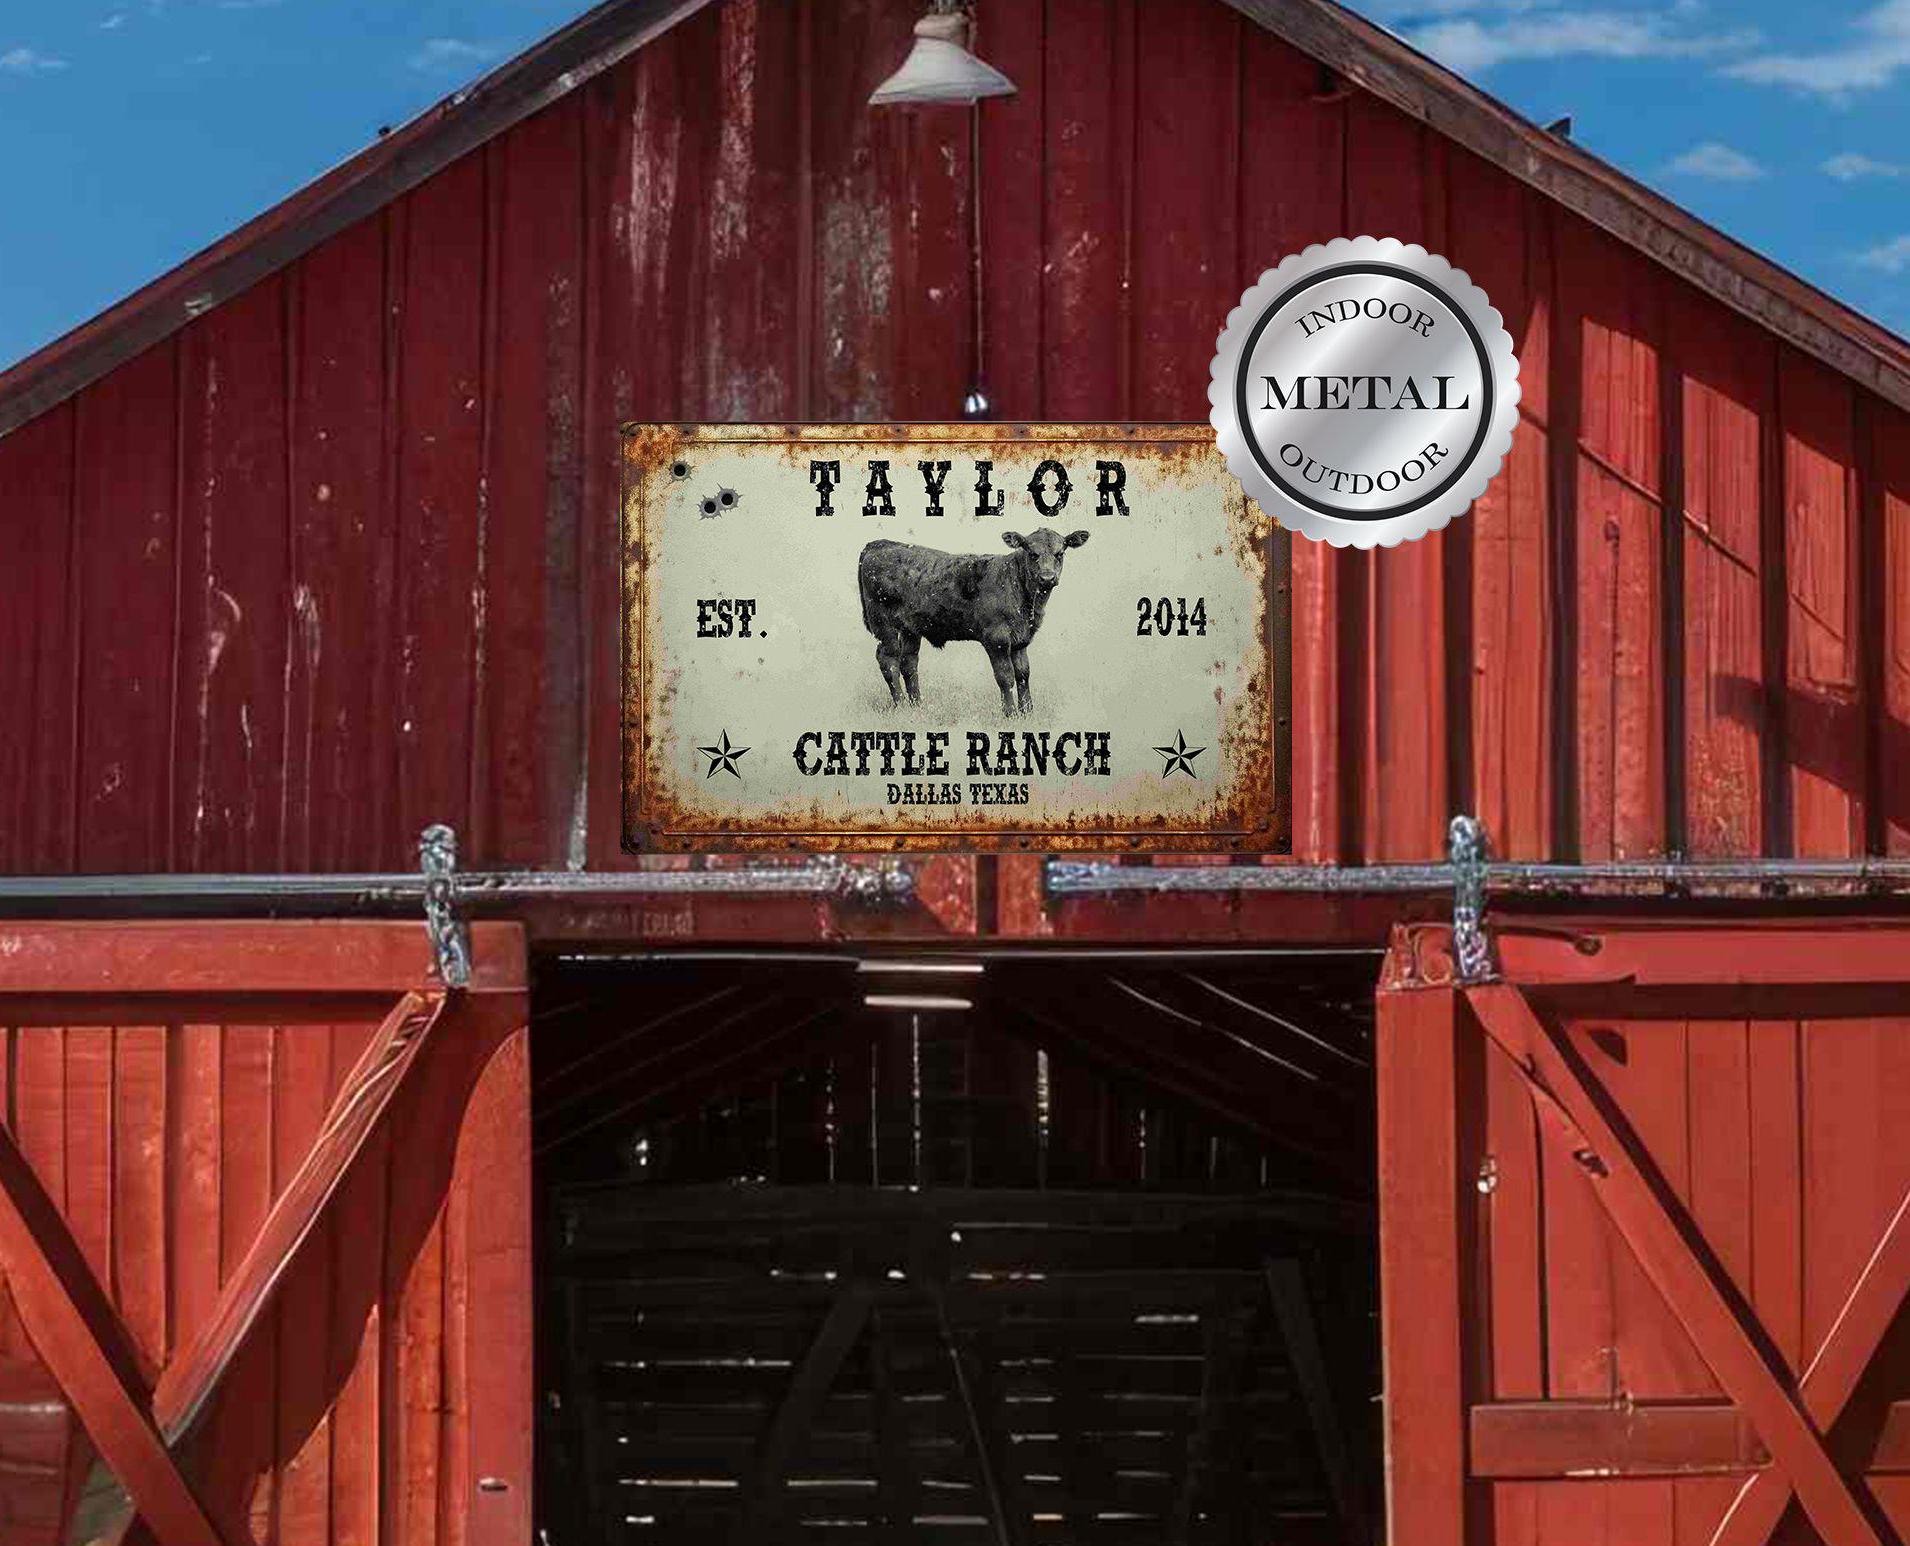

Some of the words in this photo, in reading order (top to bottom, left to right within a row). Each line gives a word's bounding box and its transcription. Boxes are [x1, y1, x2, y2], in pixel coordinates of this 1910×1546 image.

[809, 459, 1130, 517] TAYLOR
[696, 598, 768, 639] EST.
[1136, 596, 1207, 637] 2014
[792, 731, 950, 777] CATTLE
[967, 731, 1112, 777] RANCH
[886, 782, 962, 806] DALLAS
[969, 782, 1030, 806] TEXAS
